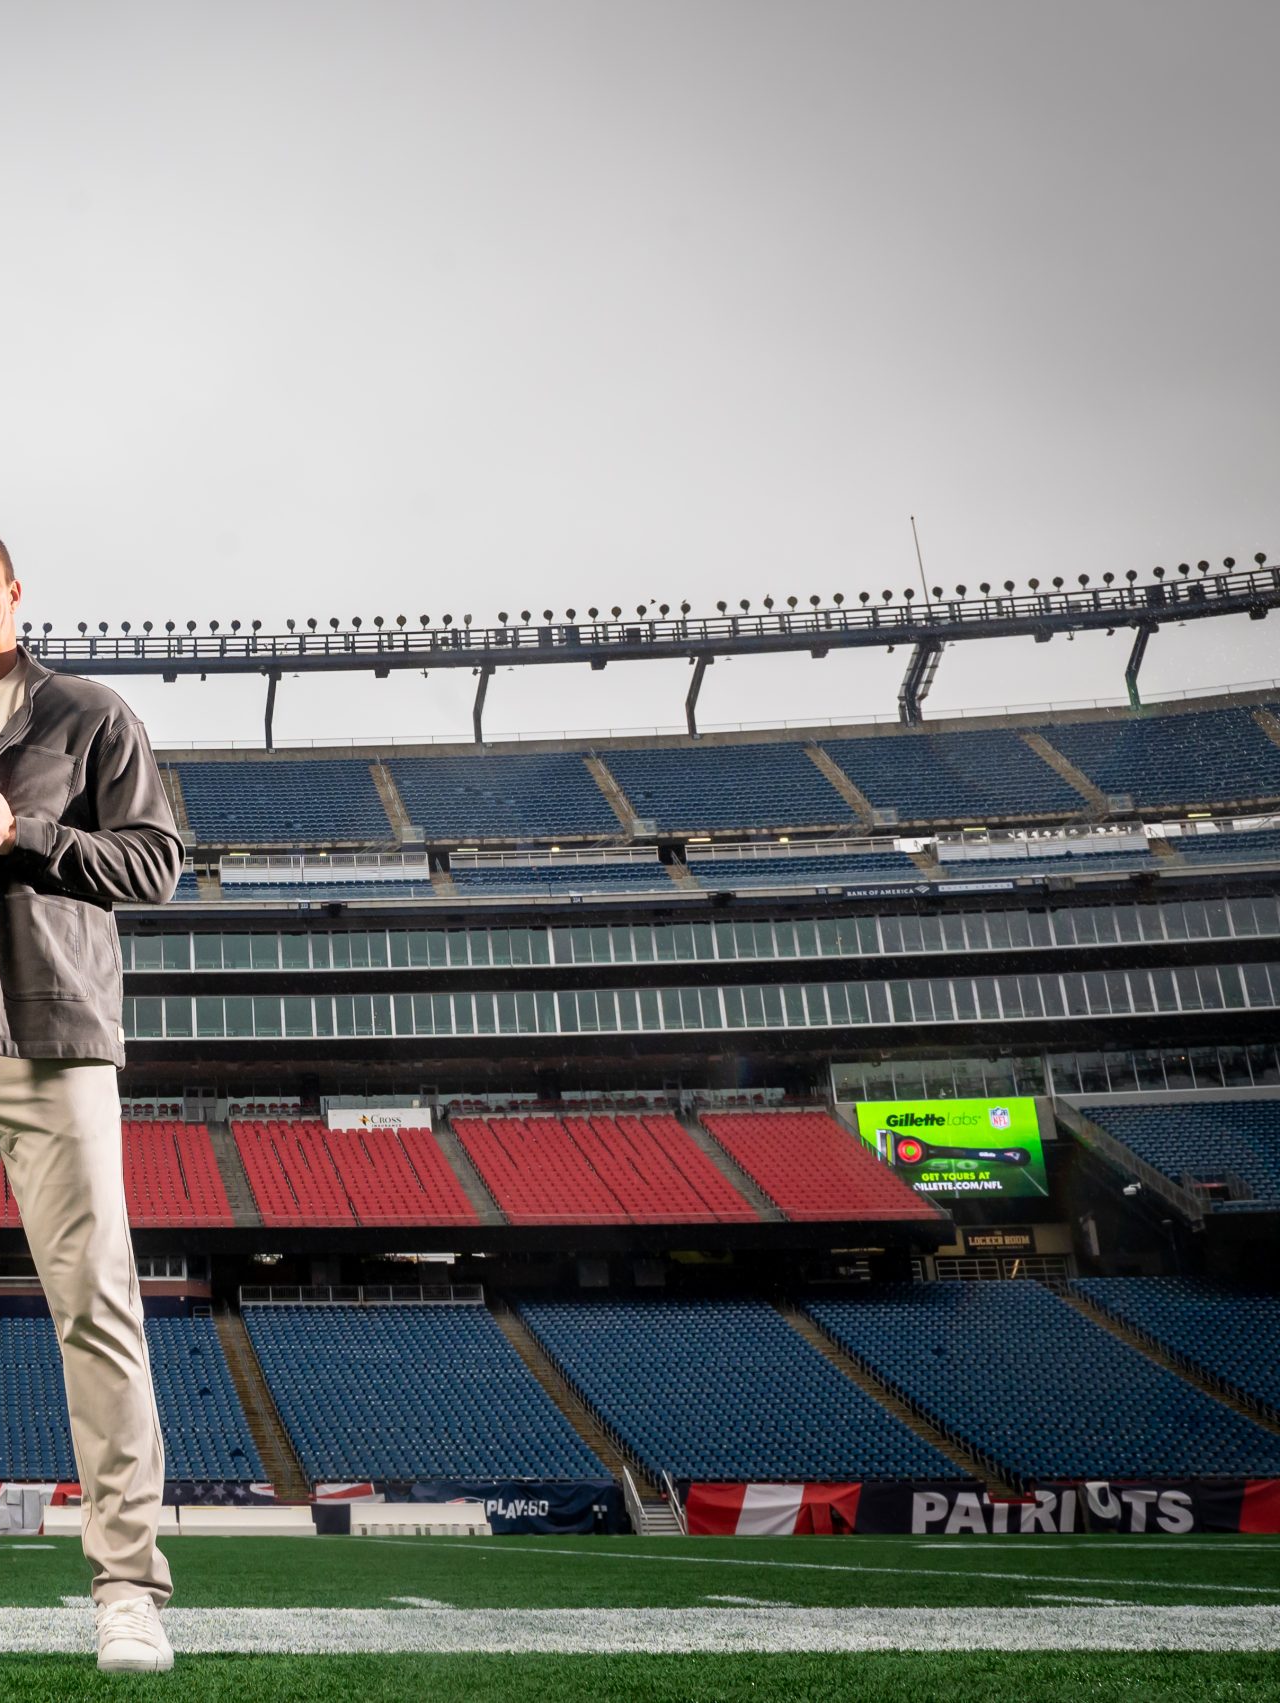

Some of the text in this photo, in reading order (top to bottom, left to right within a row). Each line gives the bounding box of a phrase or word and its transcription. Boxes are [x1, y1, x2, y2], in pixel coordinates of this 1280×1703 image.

[992, 1115, 1008, 1127] NFL
[921, 1171, 991, 1182] GET YOURS AT
[968, 1235, 1031, 1246] LOCKER ROOM
